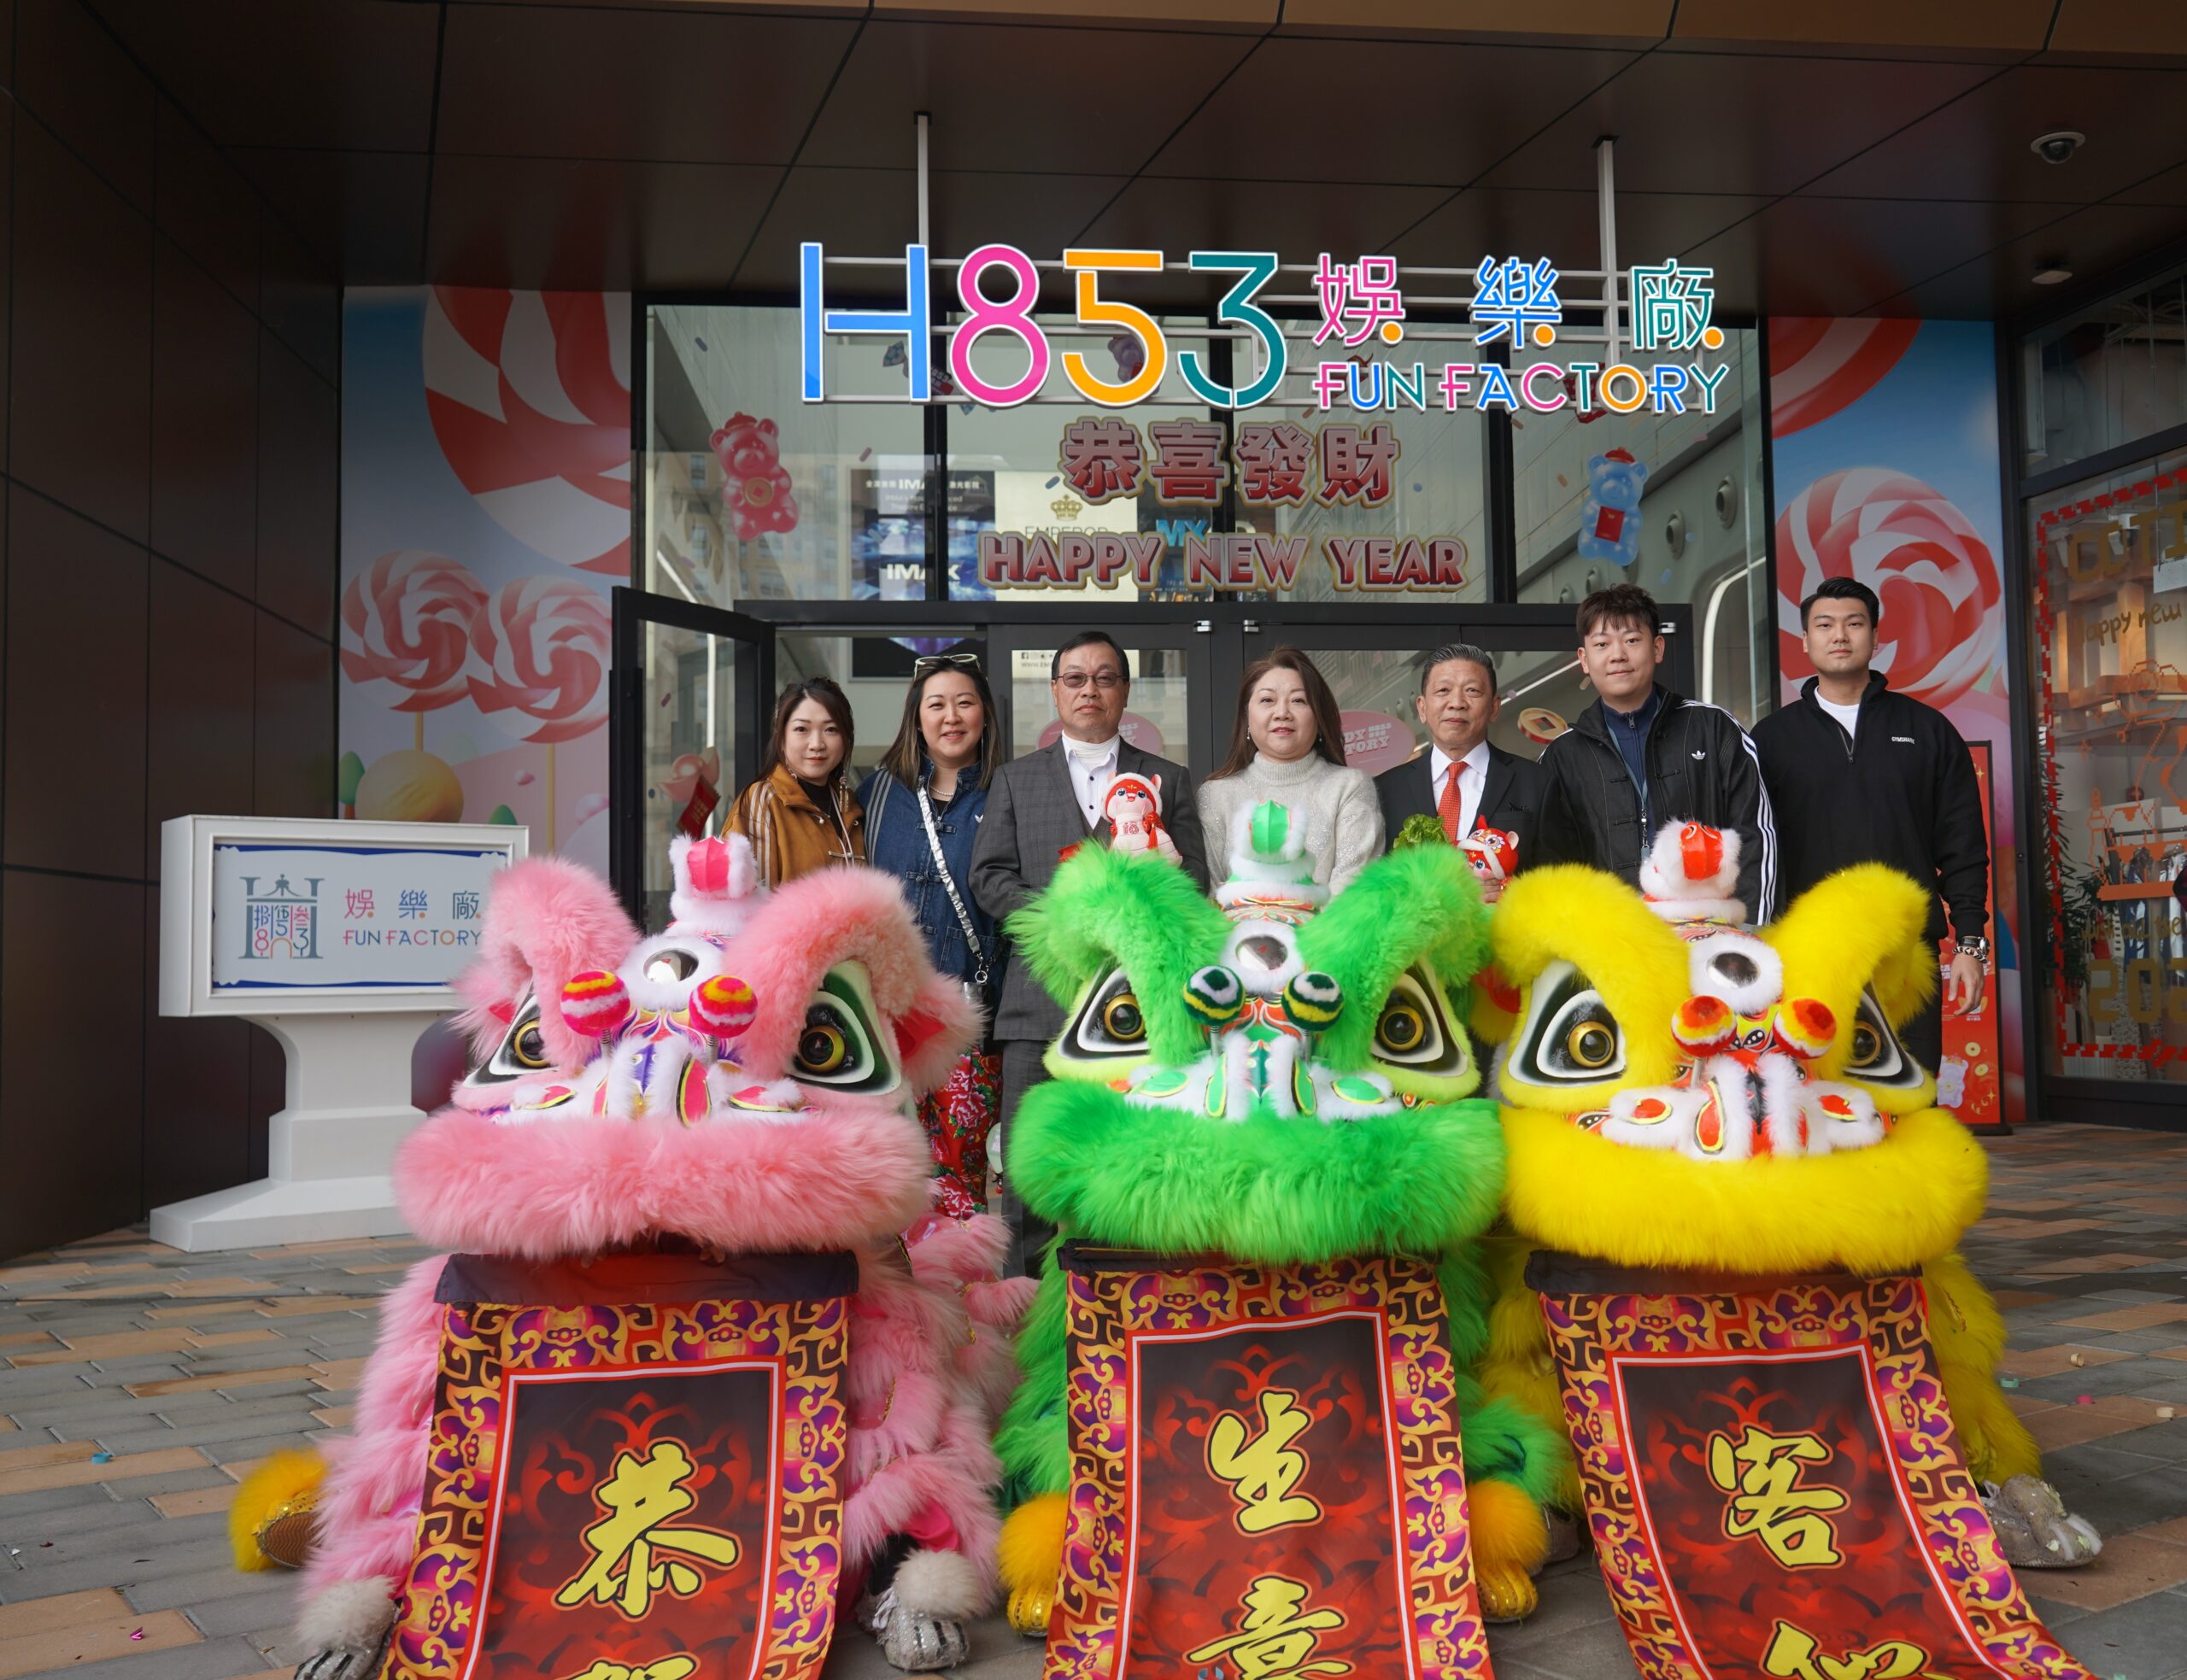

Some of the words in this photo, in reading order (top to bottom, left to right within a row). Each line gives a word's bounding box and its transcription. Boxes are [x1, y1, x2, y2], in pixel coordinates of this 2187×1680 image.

[800, 242, 1287, 409] H853
[1312, 254, 1724, 352] 娛樂廠
[1312, 361, 1426, 412] FUN
[1437, 361, 1730, 415] FACTORY
[1061, 419, 1398, 505] 恭喜發財
[887, 564, 961, 581] IMX
[982, 535, 1164, 585] HAPPY
[1187, 536, 1308, 587] NEW
[1327, 538, 1467, 588] YEAR
[1344, 735, 1391, 756] TORY
[343, 888, 482, 921] 娛樂廠
[343, 929, 381, 946] FUN
[385, 929, 482, 946] FACTORY
